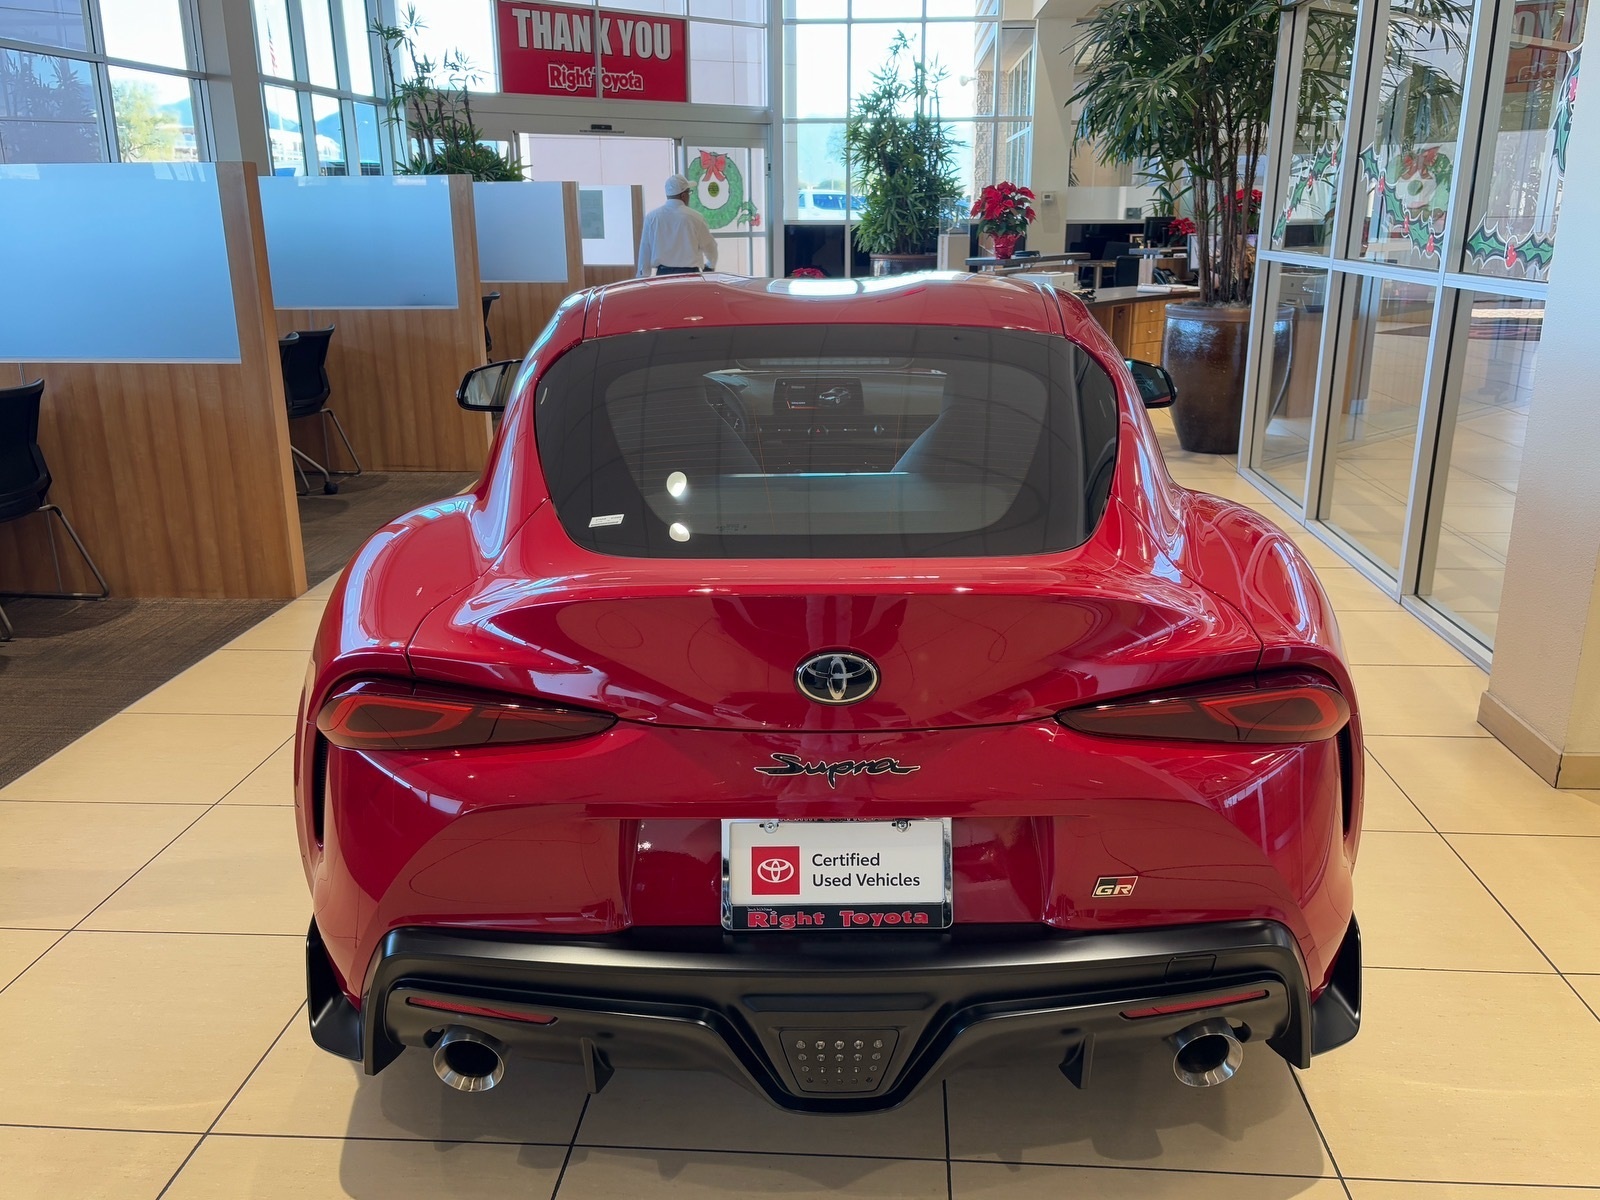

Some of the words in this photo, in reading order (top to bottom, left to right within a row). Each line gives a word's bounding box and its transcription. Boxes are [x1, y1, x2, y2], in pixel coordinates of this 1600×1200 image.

[512, 8, 613, 56] THANK
[617, 18, 672, 61] YOU
[548, 63, 593, 92] Right
[753, 752, 921, 789] Supra
[812, 853, 880, 867] Certified
[812, 873, 852, 887] Used
[856, 873, 921, 887] Vehicles
[1095, 884, 1133, 896] GR
[747, 910, 826, 930] Right
[839, 909, 930, 927] Toyota
